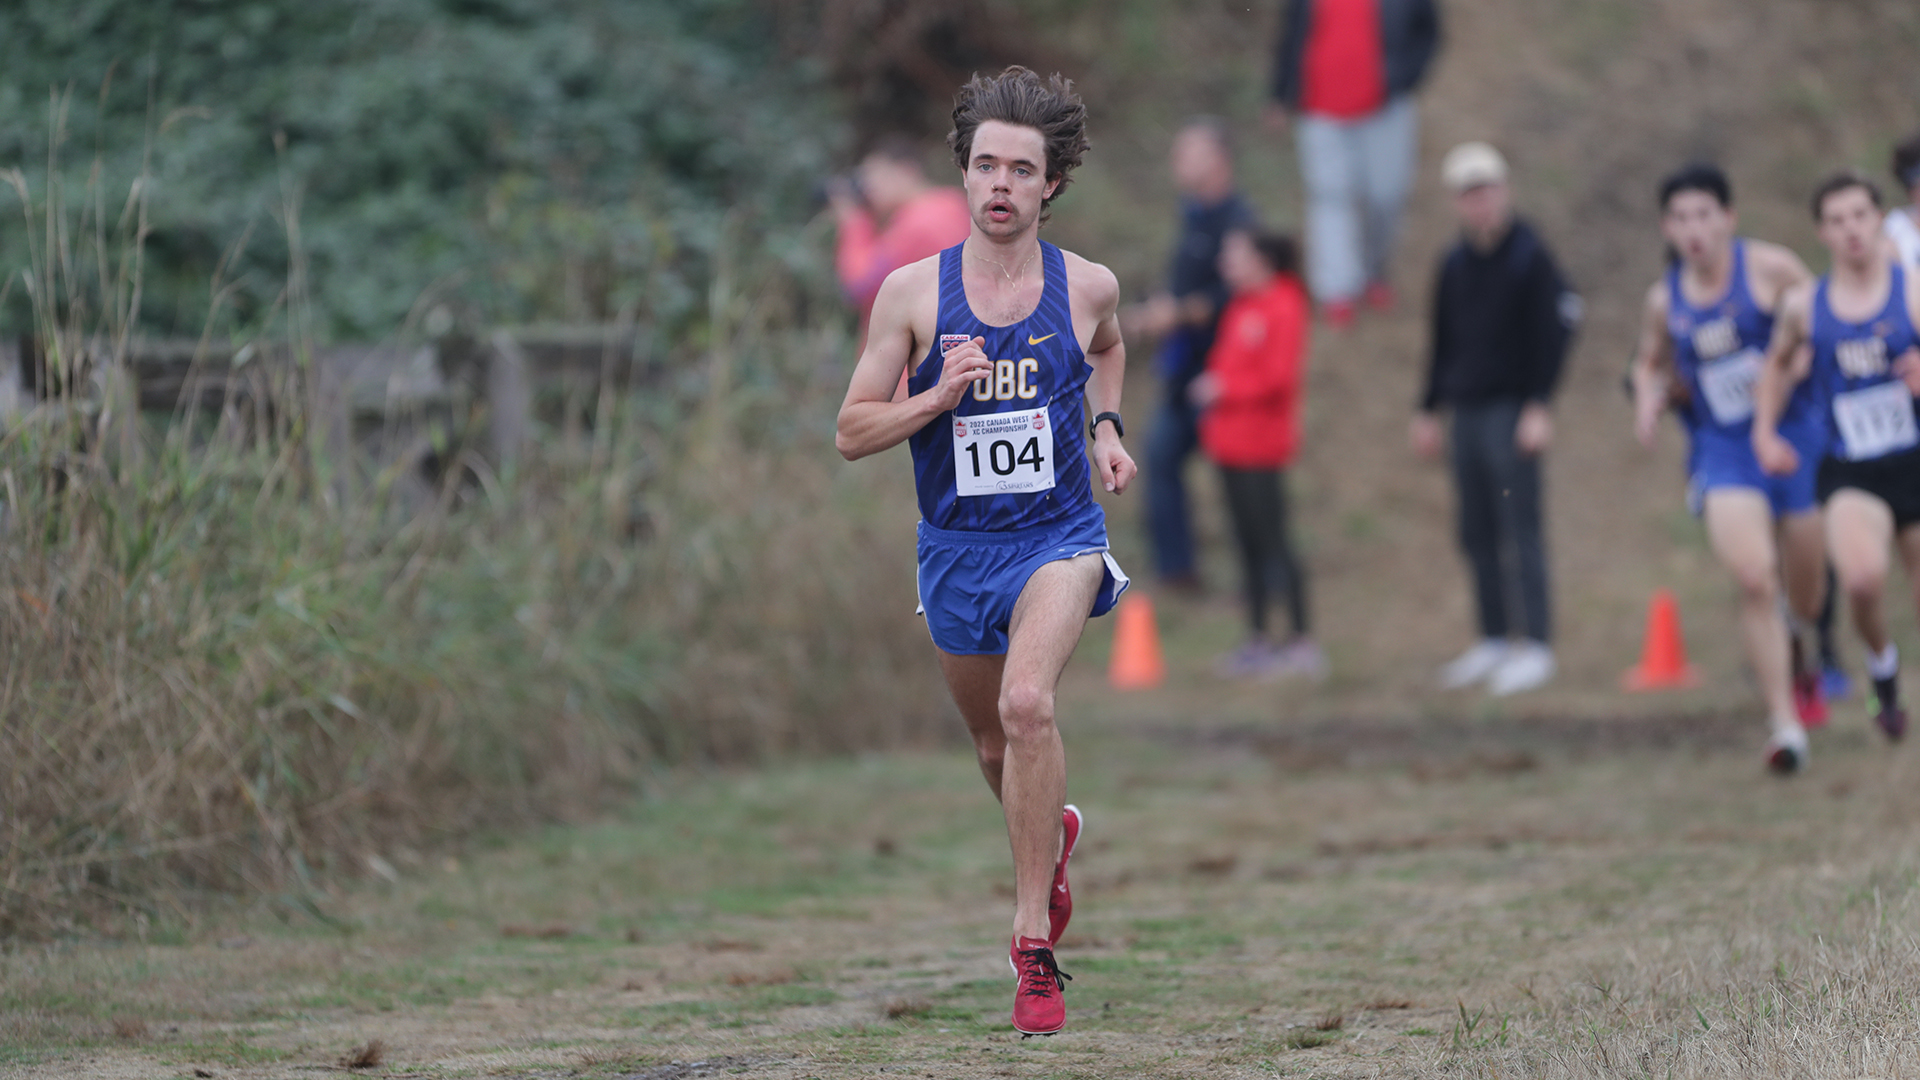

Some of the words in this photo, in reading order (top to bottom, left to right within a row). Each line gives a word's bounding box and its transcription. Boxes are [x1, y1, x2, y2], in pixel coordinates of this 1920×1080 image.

[973, 357, 1039, 402] UBC
[969, 420, 985, 428] 2022
[986, 417, 1011, 427] CANADA
[1011, 415, 1029, 424] WEST
[972, 428, 981, 436] XC
[981, 424, 1028, 435] CHAMPIONSHIP
[965, 436, 1045, 477] 104
